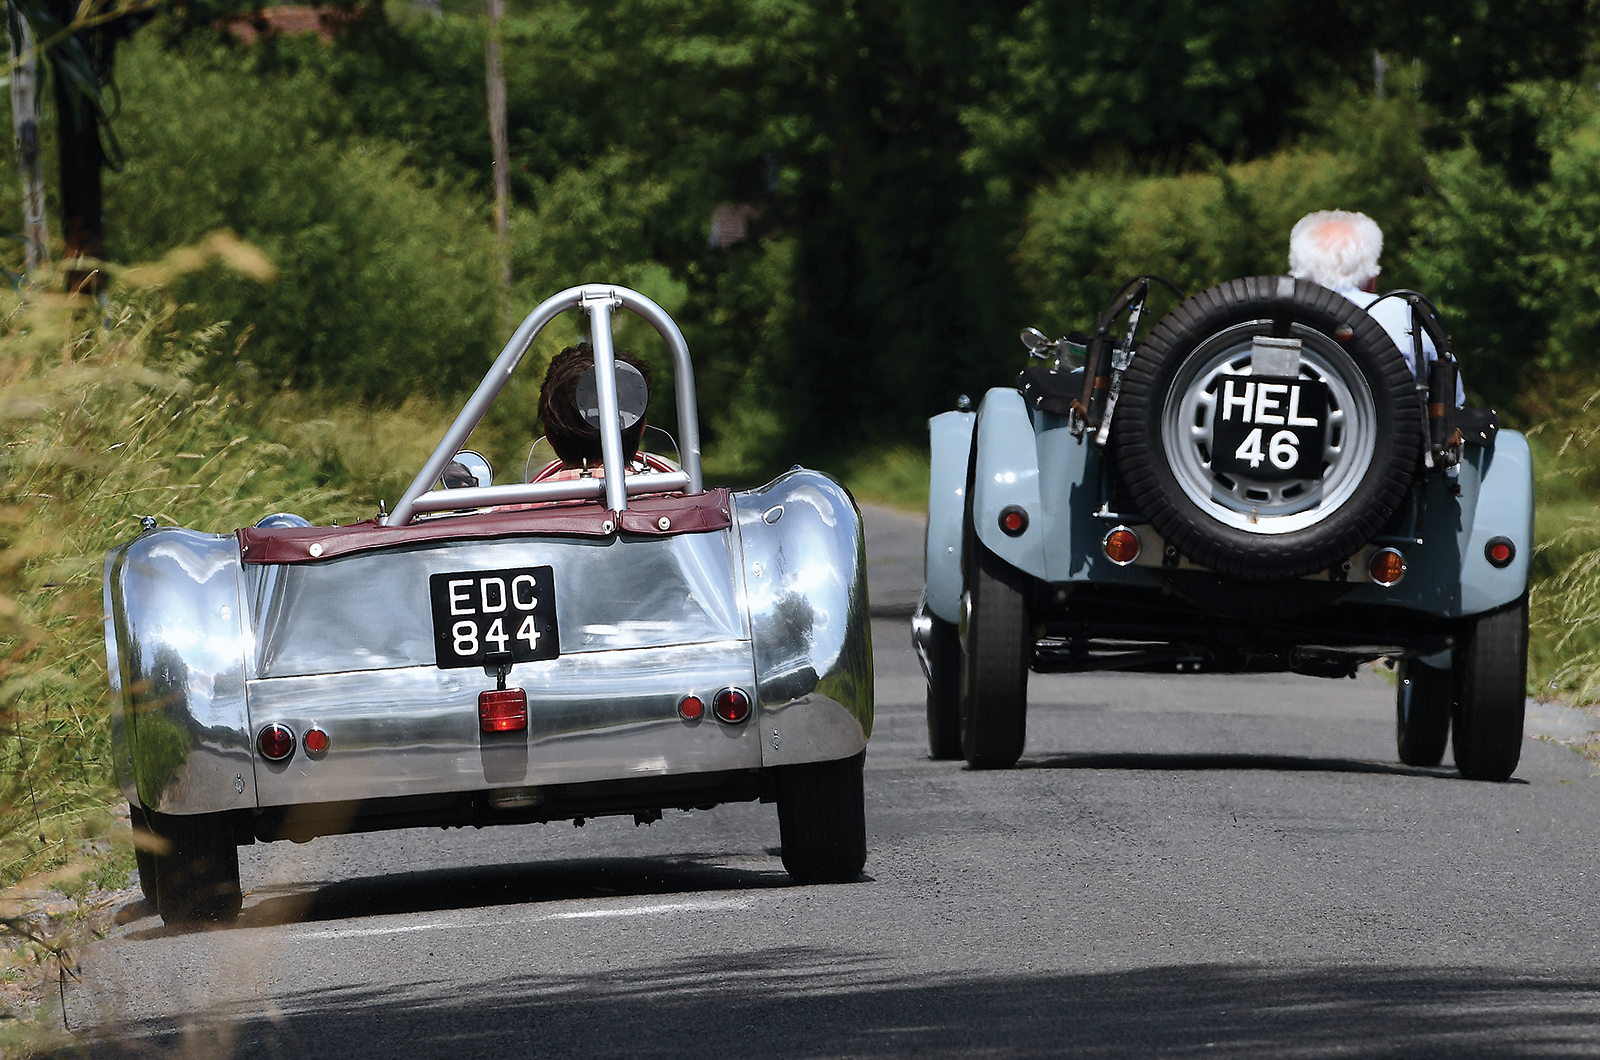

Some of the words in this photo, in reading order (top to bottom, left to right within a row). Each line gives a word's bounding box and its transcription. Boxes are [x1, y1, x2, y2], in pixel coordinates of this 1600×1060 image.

[1222, 380, 1318, 427] HEL
[1235, 428, 1300, 470] 46
[448, 574, 538, 616] EDC
[452, 614, 541, 656] 844
